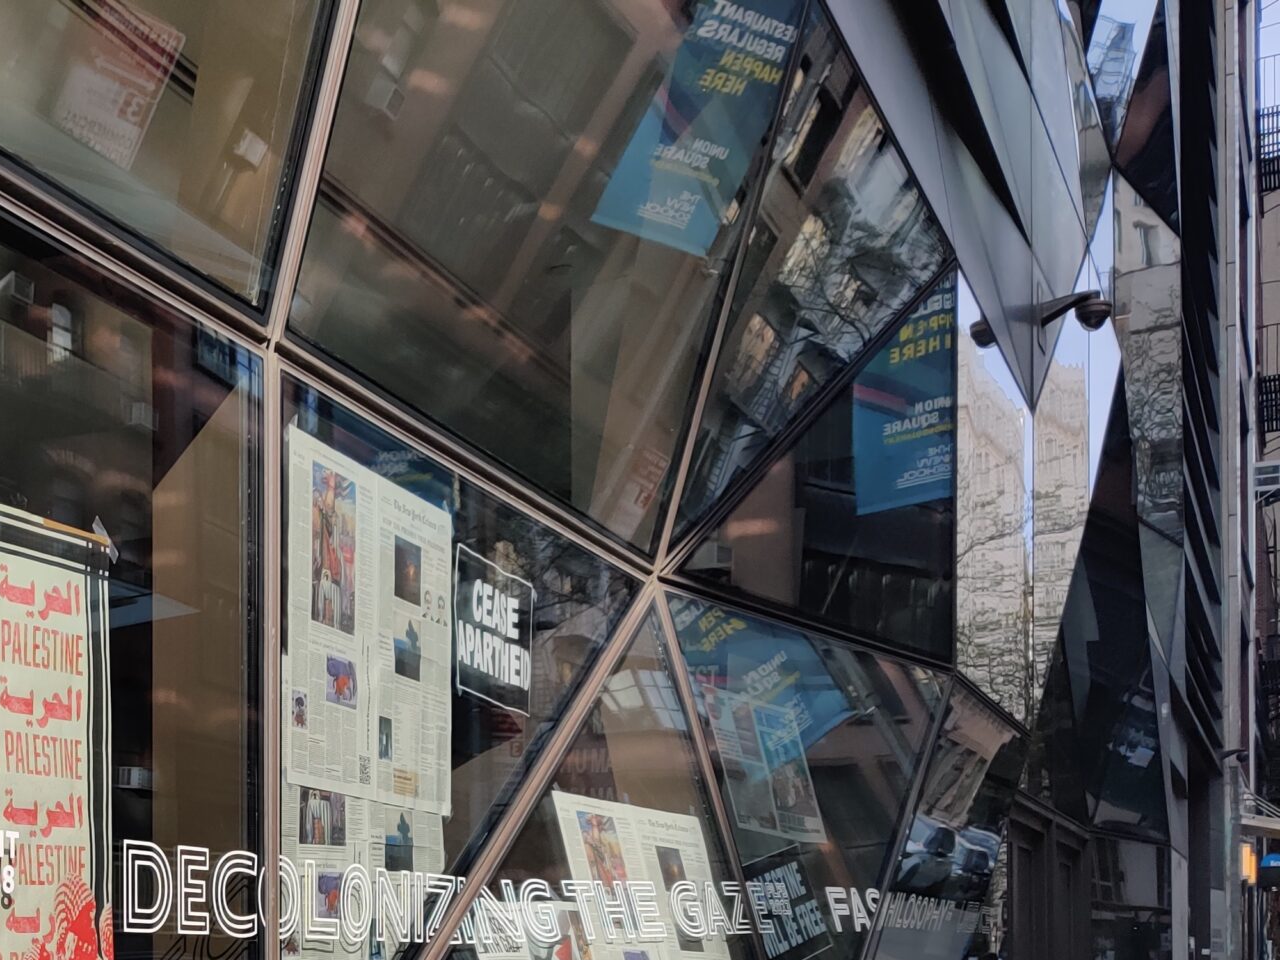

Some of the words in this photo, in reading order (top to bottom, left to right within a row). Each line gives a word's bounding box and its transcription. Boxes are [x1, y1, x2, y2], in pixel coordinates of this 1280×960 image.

[472, 578, 520, 640] CEASE
[1, 619, 84, 676] PALESTINE
[458, 619, 531, 691] APARTHEID
[0, 675, 82, 729] الحرية
[4, 729, 83, 780] PALESTINE
[3, 786, 84, 838] الحرية
[12, 842, 87, 887] ALESTINE
[123, 839, 561, 943] DECOLONIZING
[561, 879, 667, 940] THE
[670, 880, 775, 936] GAZE
[795, 898, 827, 941] FREE
[878, 891, 951, 931] HILOSOPHY
